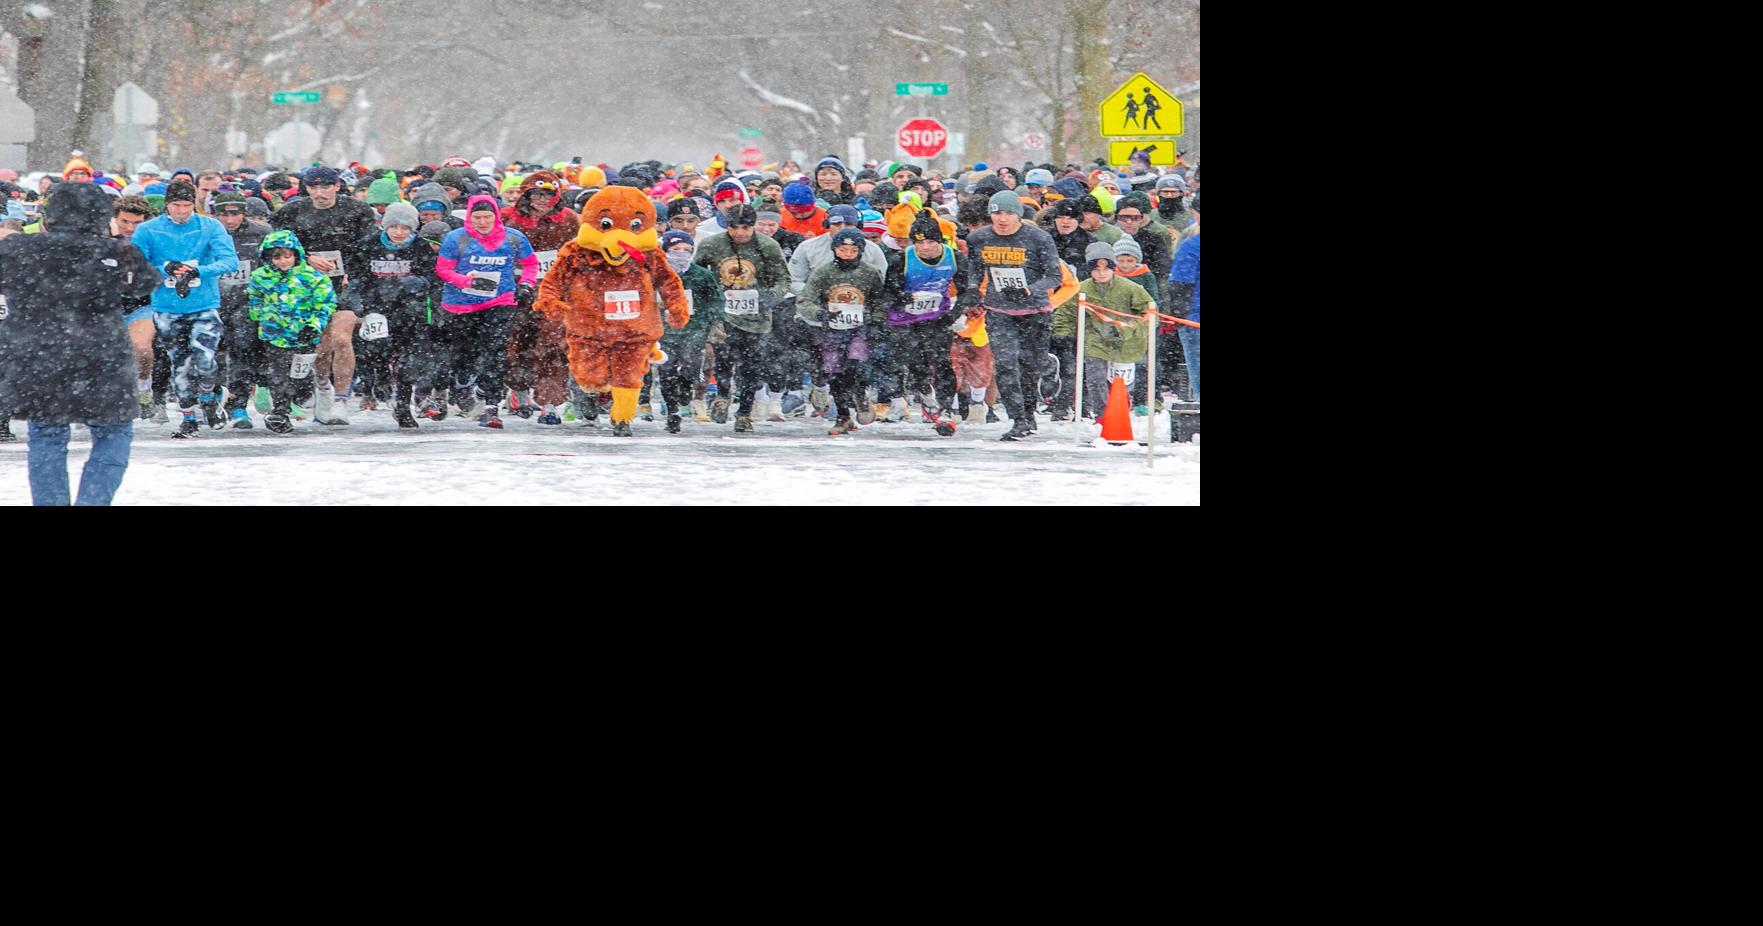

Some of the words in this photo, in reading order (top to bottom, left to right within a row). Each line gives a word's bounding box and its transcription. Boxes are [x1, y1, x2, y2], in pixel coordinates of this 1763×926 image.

[901, 130, 944, 147] STOP
[996, 277, 1024, 288] 1585
[616, 301, 630, 313] 18
[728, 299, 755, 310] 3739
[909, 300, 936, 311] 1971
